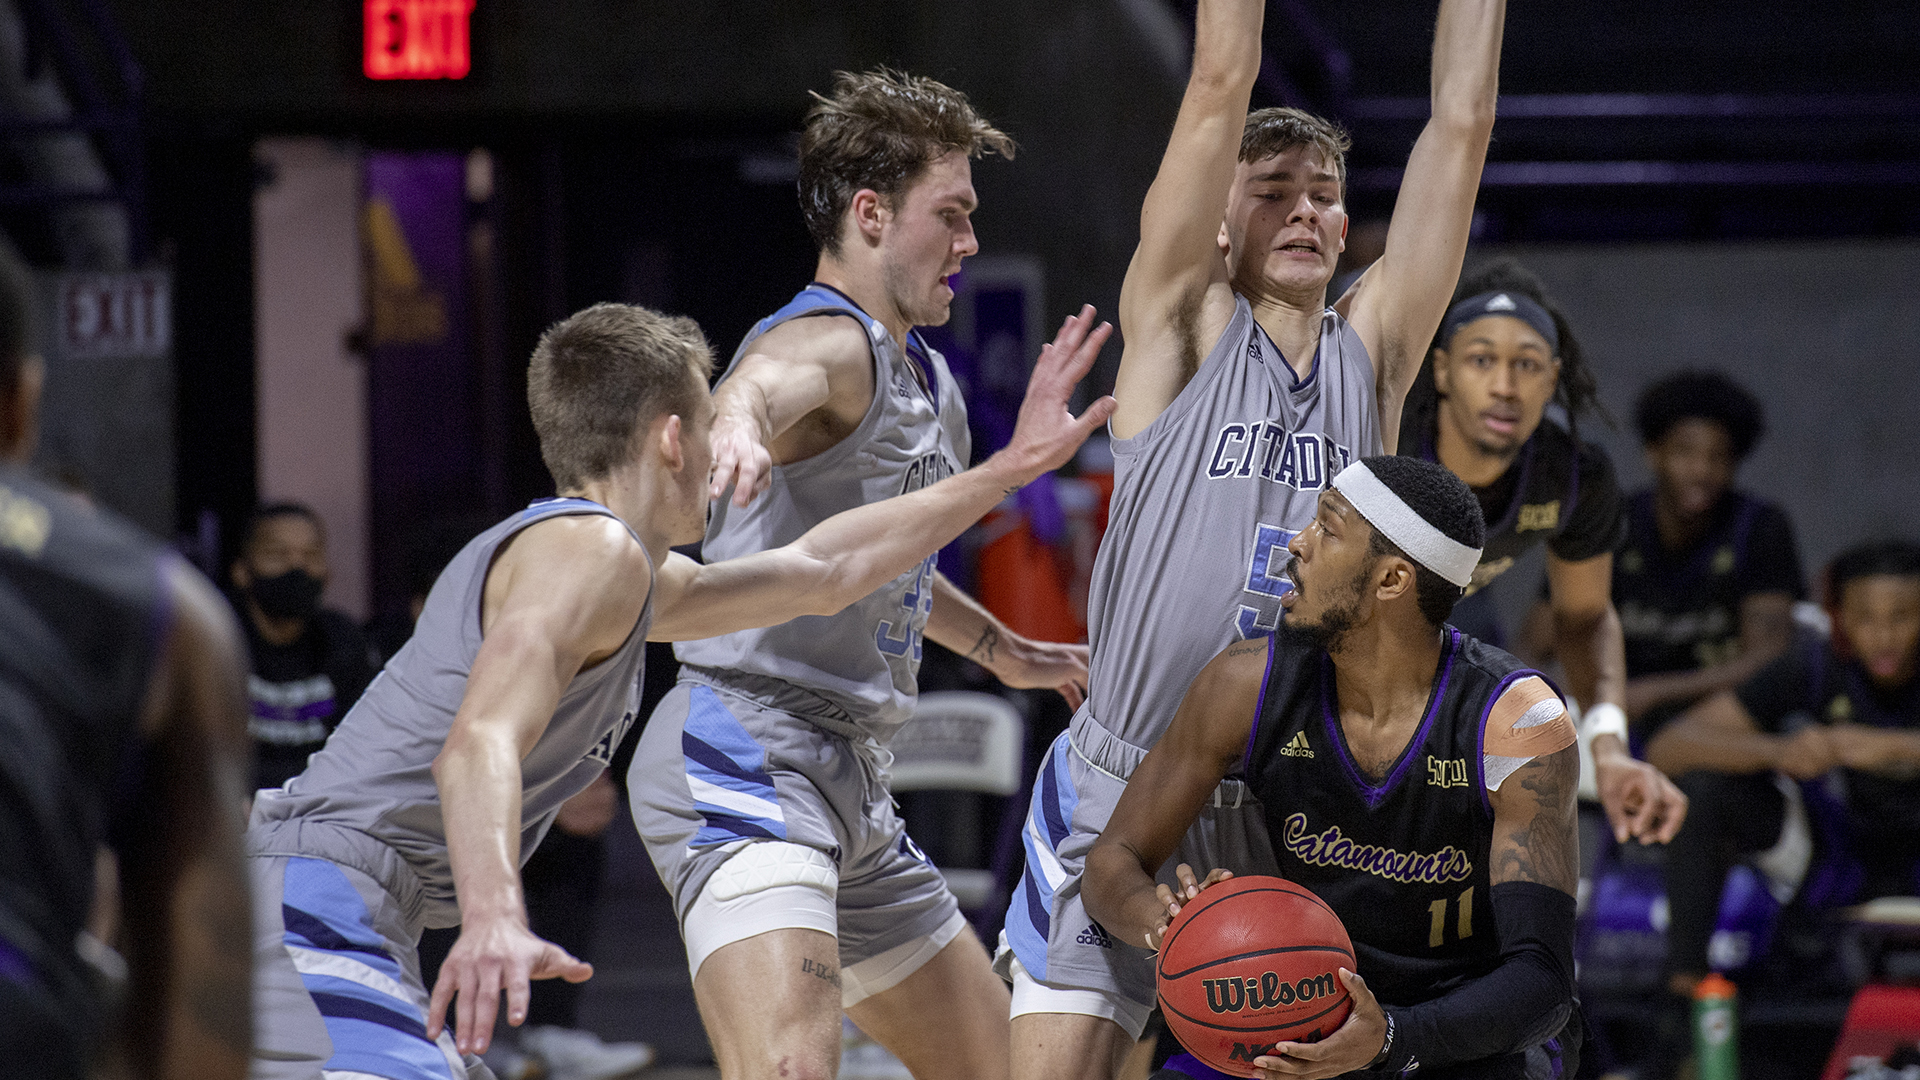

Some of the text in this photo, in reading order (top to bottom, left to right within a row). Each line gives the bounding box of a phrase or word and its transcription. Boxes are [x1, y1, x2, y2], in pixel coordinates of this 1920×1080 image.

[363, 0, 476, 79] EXIT
[66, 279, 160, 344] EXIT
[1234, 523, 1302, 640] 5
[1280, 747, 1315, 759] adidas
[1283, 812, 1473, 884] Catamounts
[1076, 934, 1113, 949] adidas
[1427, 885, 1475, 948] 11
[1202, 971, 1337, 1013] Wilson
